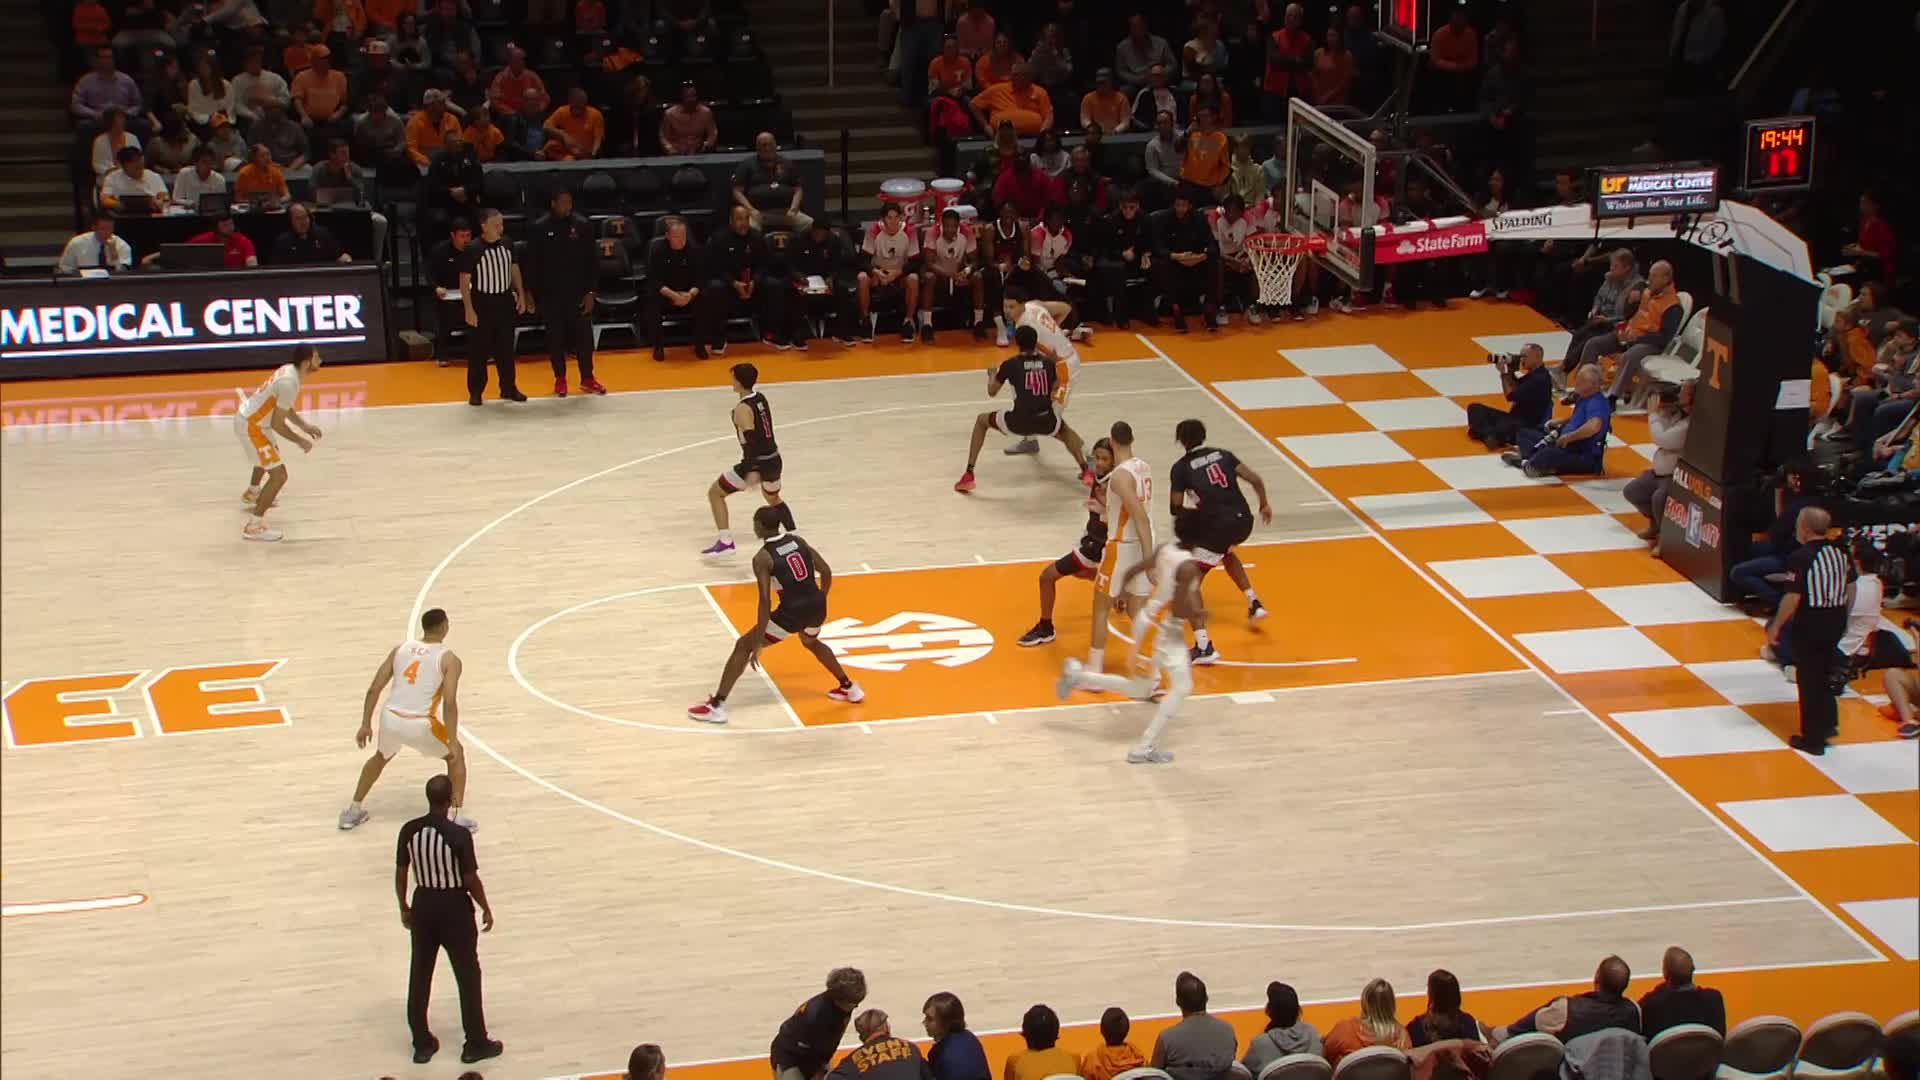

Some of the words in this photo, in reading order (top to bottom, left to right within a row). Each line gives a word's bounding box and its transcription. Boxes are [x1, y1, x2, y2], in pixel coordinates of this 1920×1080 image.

[1760, 128, 1804, 150] 19:44
[1770, 148, 1798, 177] 17
[1601, 176, 1628, 194] UT
[1628, 179, 1673, 193] MEDICAL
[1674, 176, 1713, 190] CENTER
[1605, 200, 1644, 211] Wisdom
[1646, 197, 1660, 208] for
[1663, 197, 1684, 207] Your
[1686, 194, 1708, 205] Life.
[1492, 213, 1553, 232] SPALDING
[1416, 233, 1484, 253] StateFarm
[1, 303, 195, 346] MEDICAL
[204, 294, 365, 336] CENTER
[1706, 336, 1729, 391] T
[1025, 368, 1049, 396] 41
[1205, 463, 1229, 489] 4
[785, 551, 809, 582] 0
[816, 611, 995, 672] SEC
[402, 659, 422, 686] 4
[851, 1039, 910, 1066] EVENT
[856, 1045, 913, 1073] STAFF
